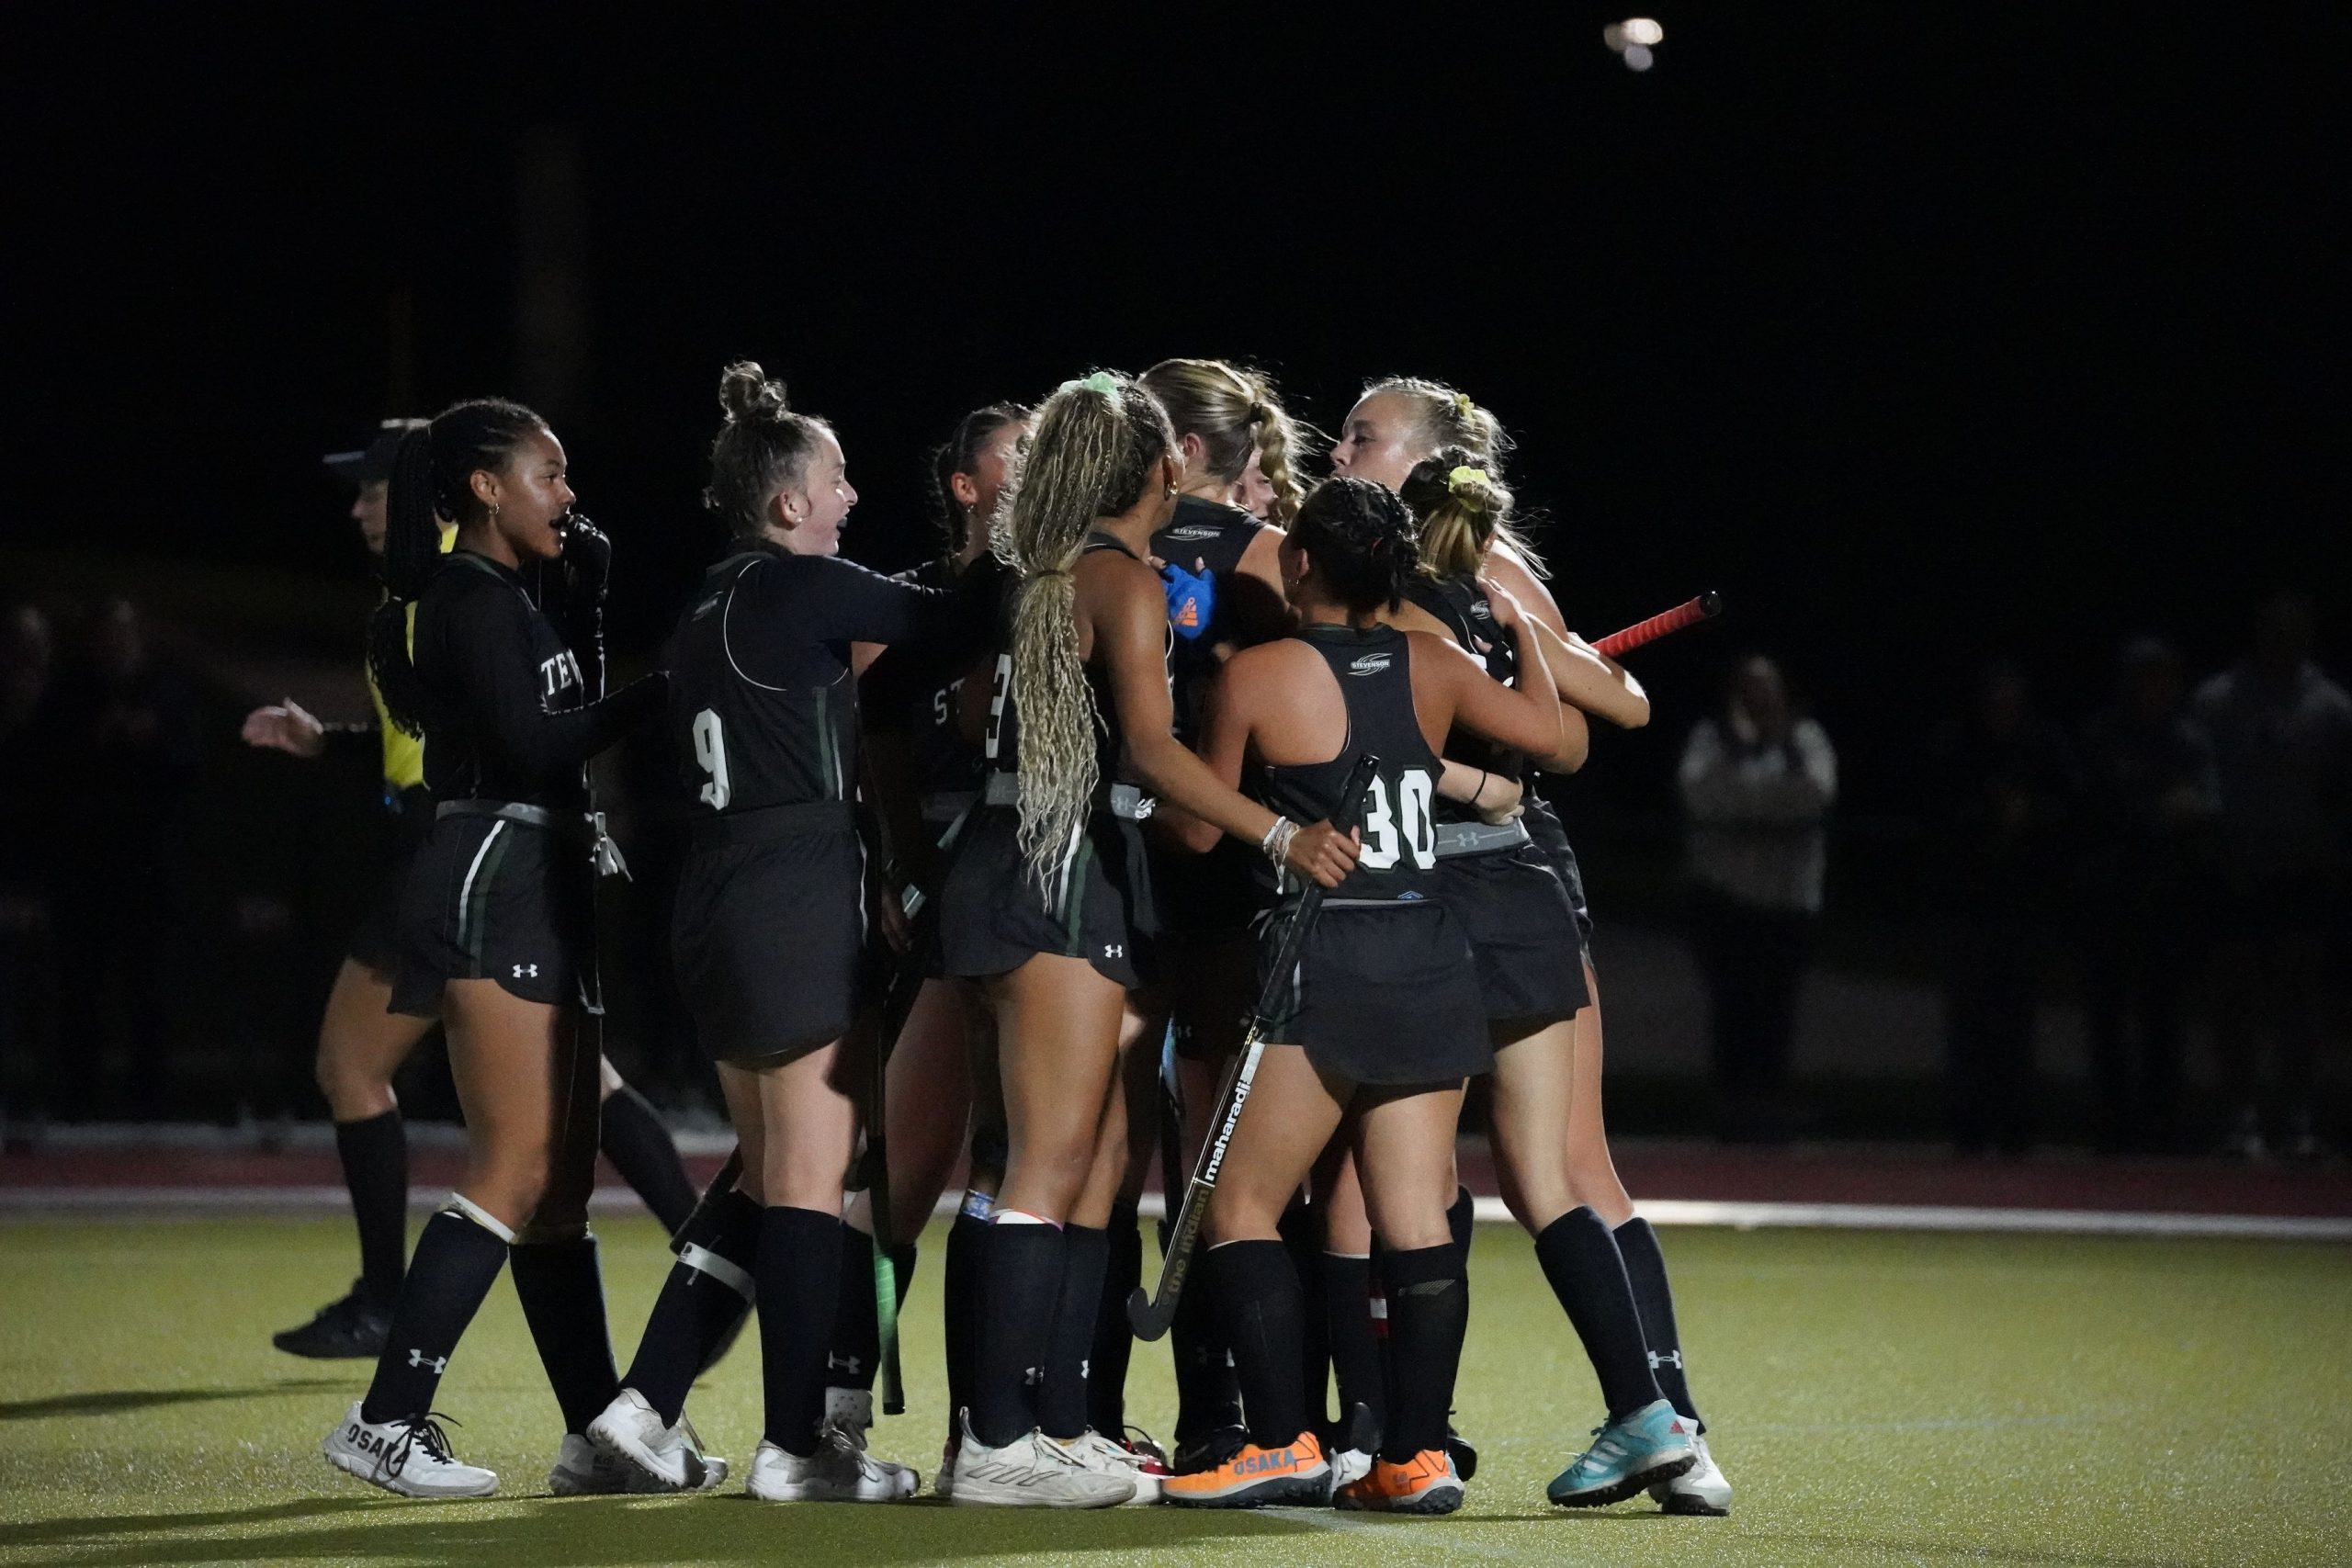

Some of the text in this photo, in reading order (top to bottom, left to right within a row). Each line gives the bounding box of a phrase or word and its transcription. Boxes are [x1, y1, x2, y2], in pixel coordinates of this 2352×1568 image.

[1351, 660, 1390, 669] STEVENSON
[693, 707, 731, 811] 9
[1359, 769, 1437, 870] 30
[1204, 1078, 1251, 1183] maharadj
[1233, 1449, 1295, 1475] OSAKA
